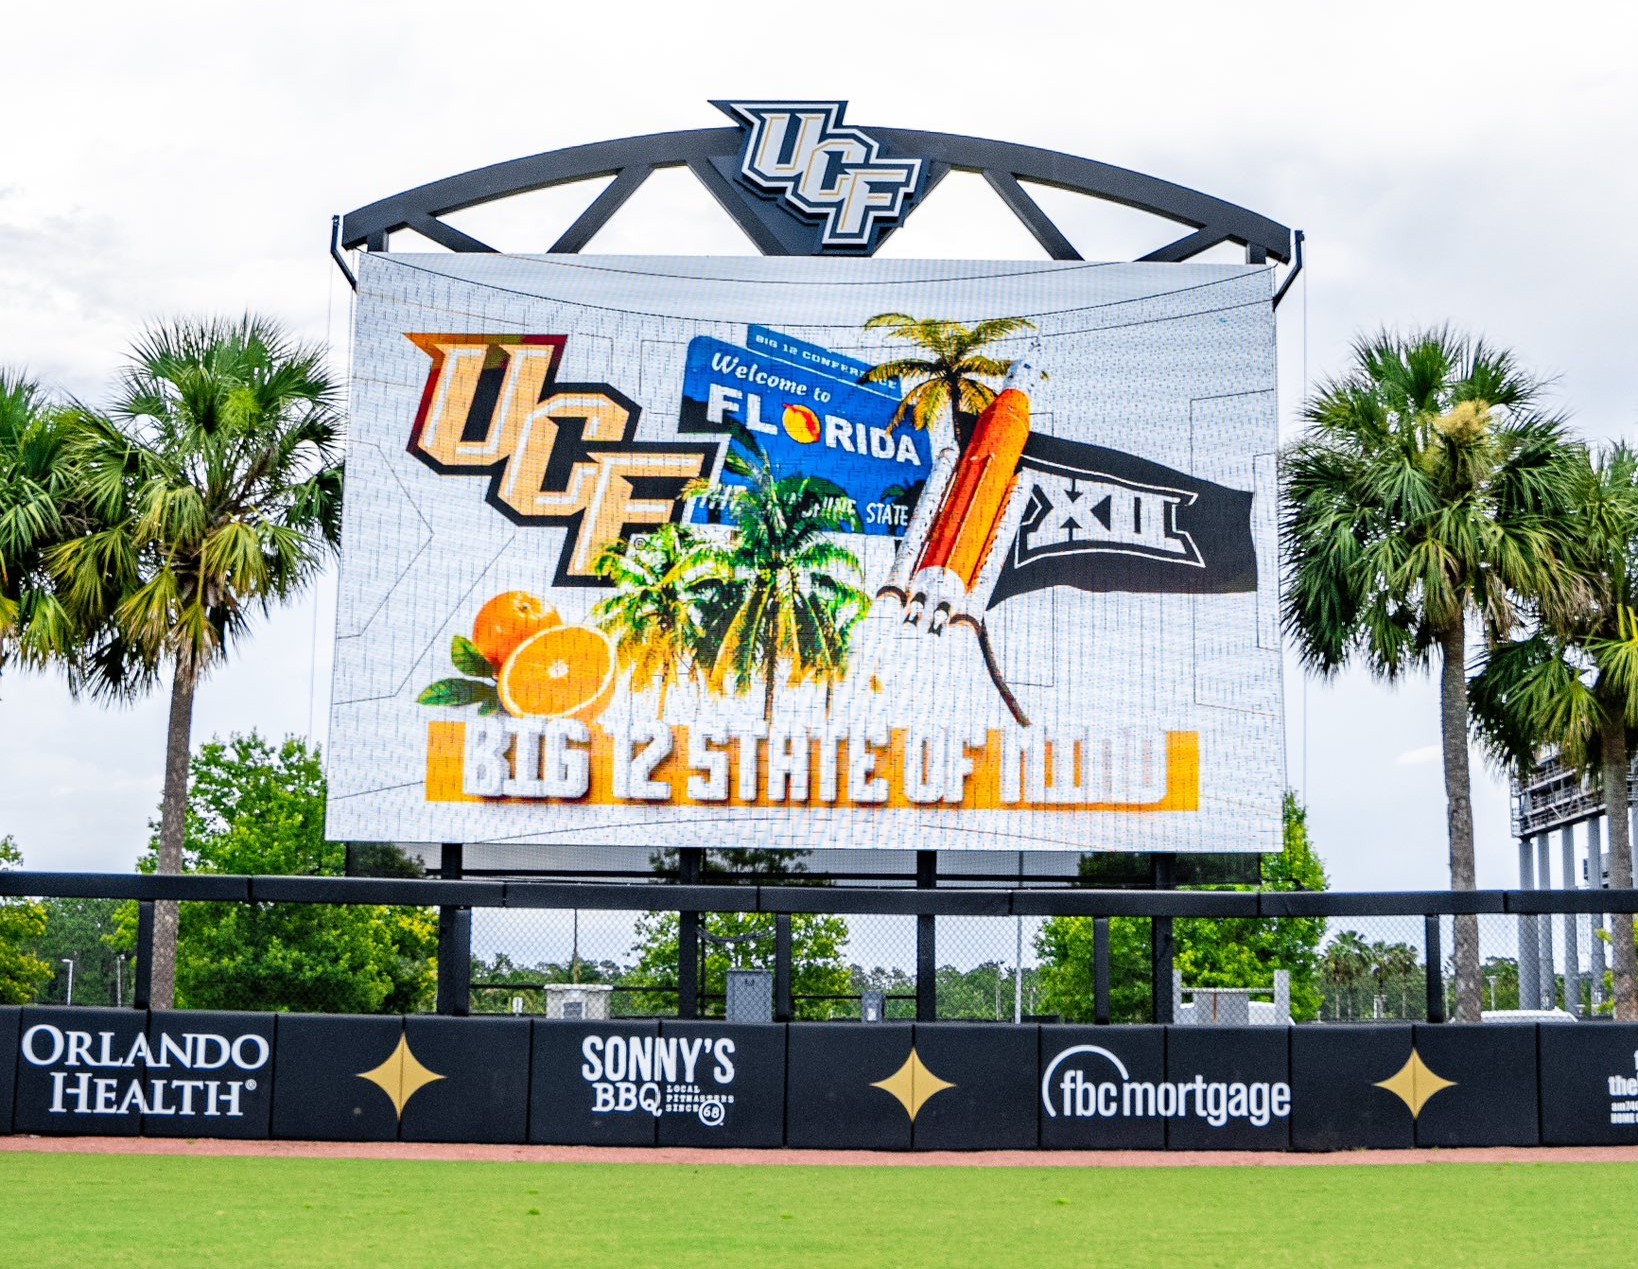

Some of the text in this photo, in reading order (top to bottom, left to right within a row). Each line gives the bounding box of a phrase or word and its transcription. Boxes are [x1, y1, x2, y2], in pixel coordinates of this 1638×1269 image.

[730, 104, 922, 244] UCF
[755, 335, 778, 349] BIG
[783, 344, 798, 356] 12
[711, 352, 832, 404] Welcome to
[706, 383, 921, 466] FLORIDA
[403, 333, 730, 588] UCF
[866, 502, 909, 526] STATE
[463, 716, 590, 799] BIG
[601, 719, 673, 800] 12
[688, 719, 889, 803] STATE
[903, 725, 988, 803] OF
[22, 1024, 269, 1070] ORLANDO
[582, 1035, 736, 1084] SONNY'S
[592, 1082, 662, 1117] BBQ
[666, 1085, 700, 1094] LOCAL
[703, 1105, 720, 1119] 68
[1060, 1069, 1291, 1127] fbc mortgage
